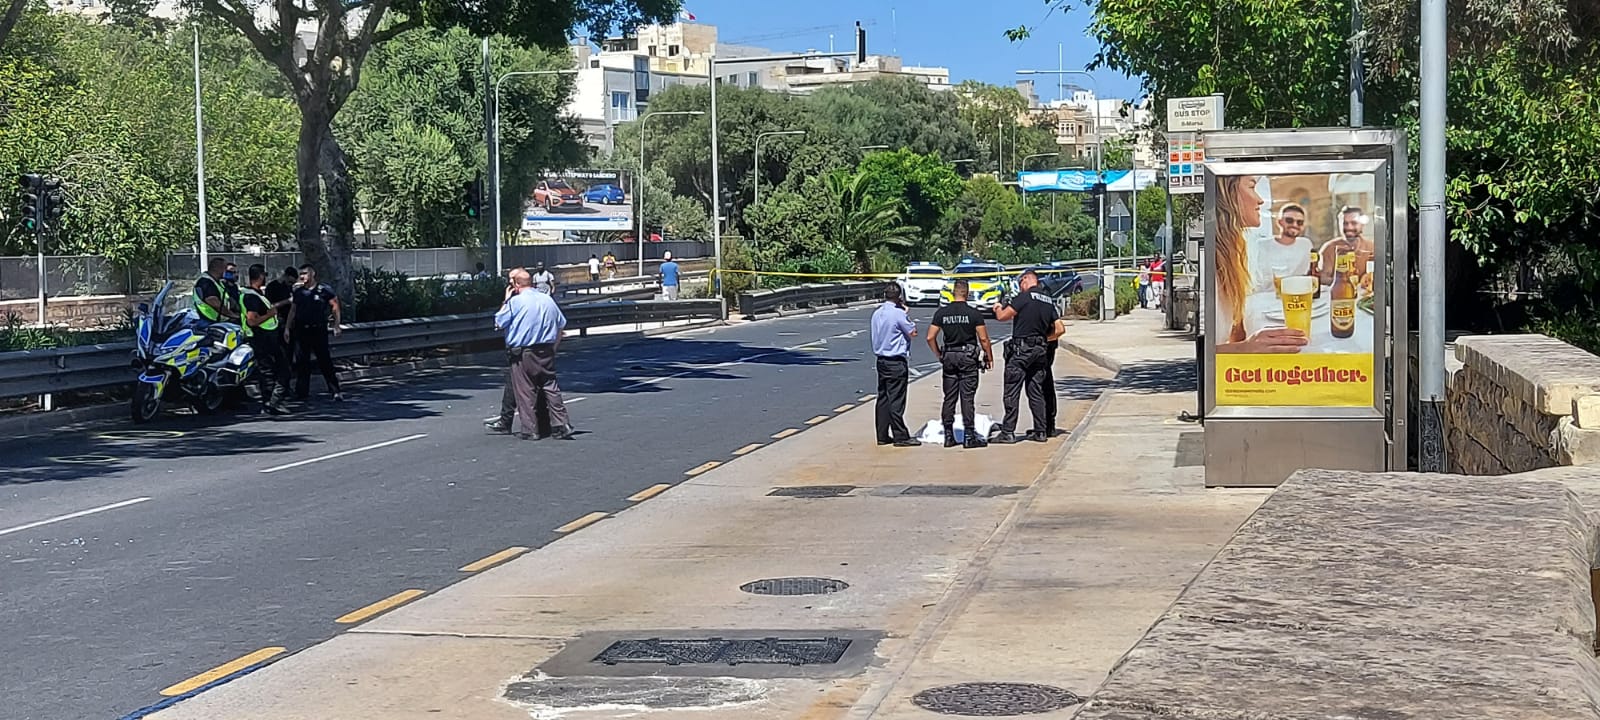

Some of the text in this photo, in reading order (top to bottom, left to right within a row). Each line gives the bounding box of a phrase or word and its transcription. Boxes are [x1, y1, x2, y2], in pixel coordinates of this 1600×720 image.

[1174, 109, 1210, 118] BUS STOP
[1333, 309, 1353, 317] CISK
[1225, 366, 1368, 385] Get together.
